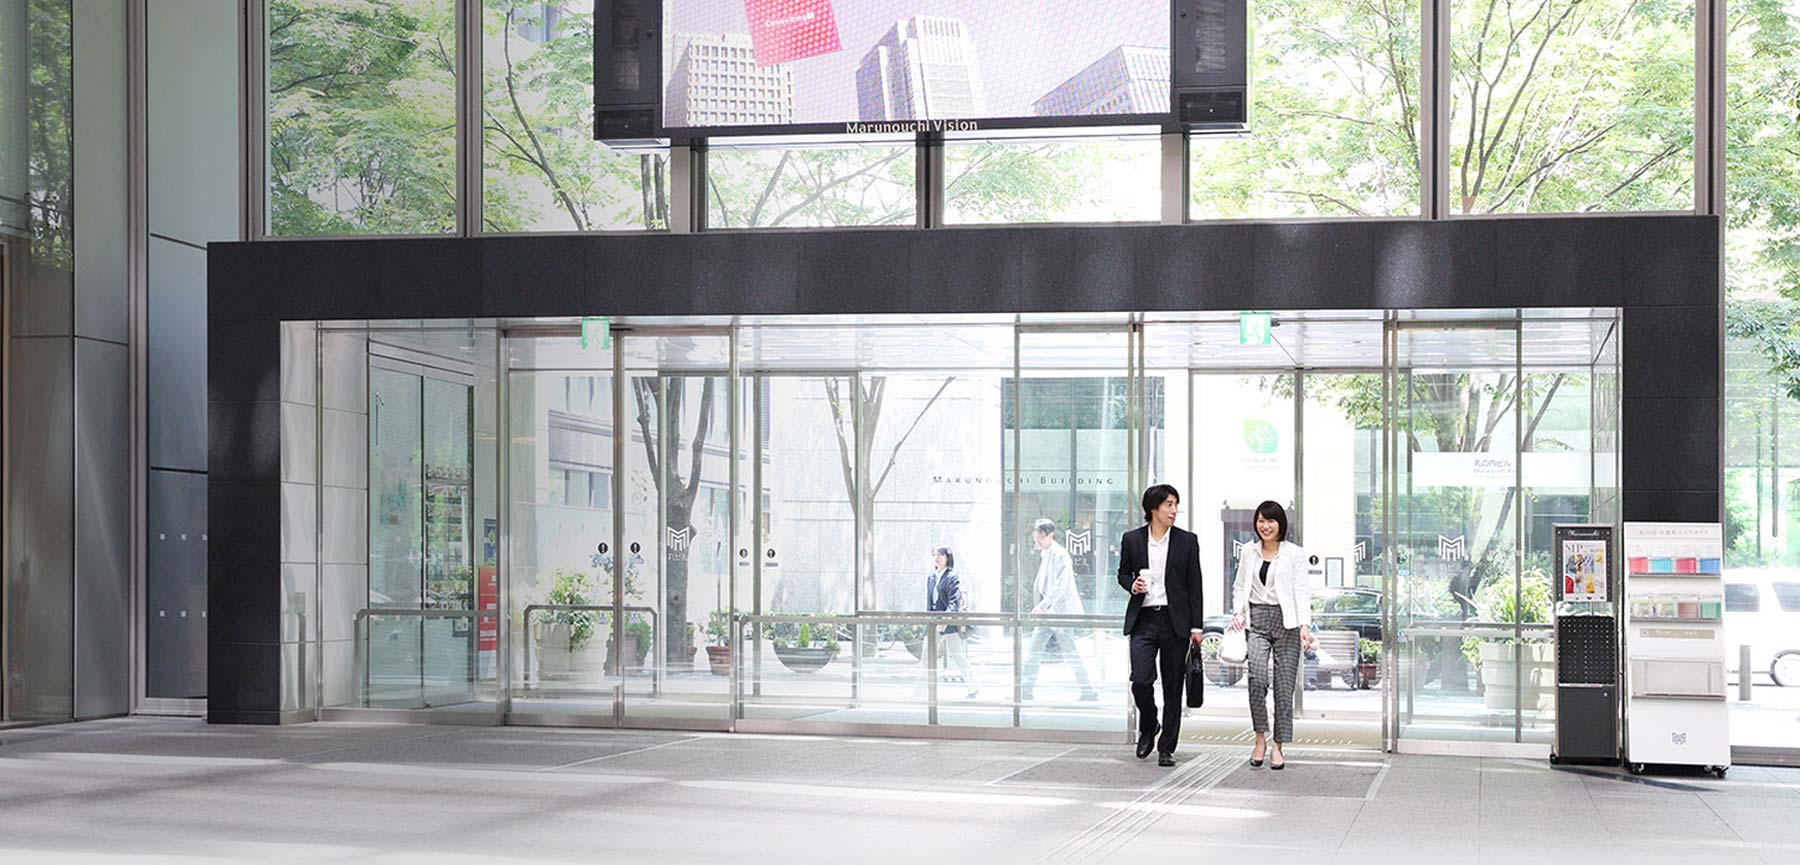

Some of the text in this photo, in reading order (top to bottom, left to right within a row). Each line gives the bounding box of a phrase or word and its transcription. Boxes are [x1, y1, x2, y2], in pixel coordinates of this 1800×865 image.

[846, 119, 978, 134] Marunouchi Vision
[933, 476, 1030, 484] MARUNOCI
